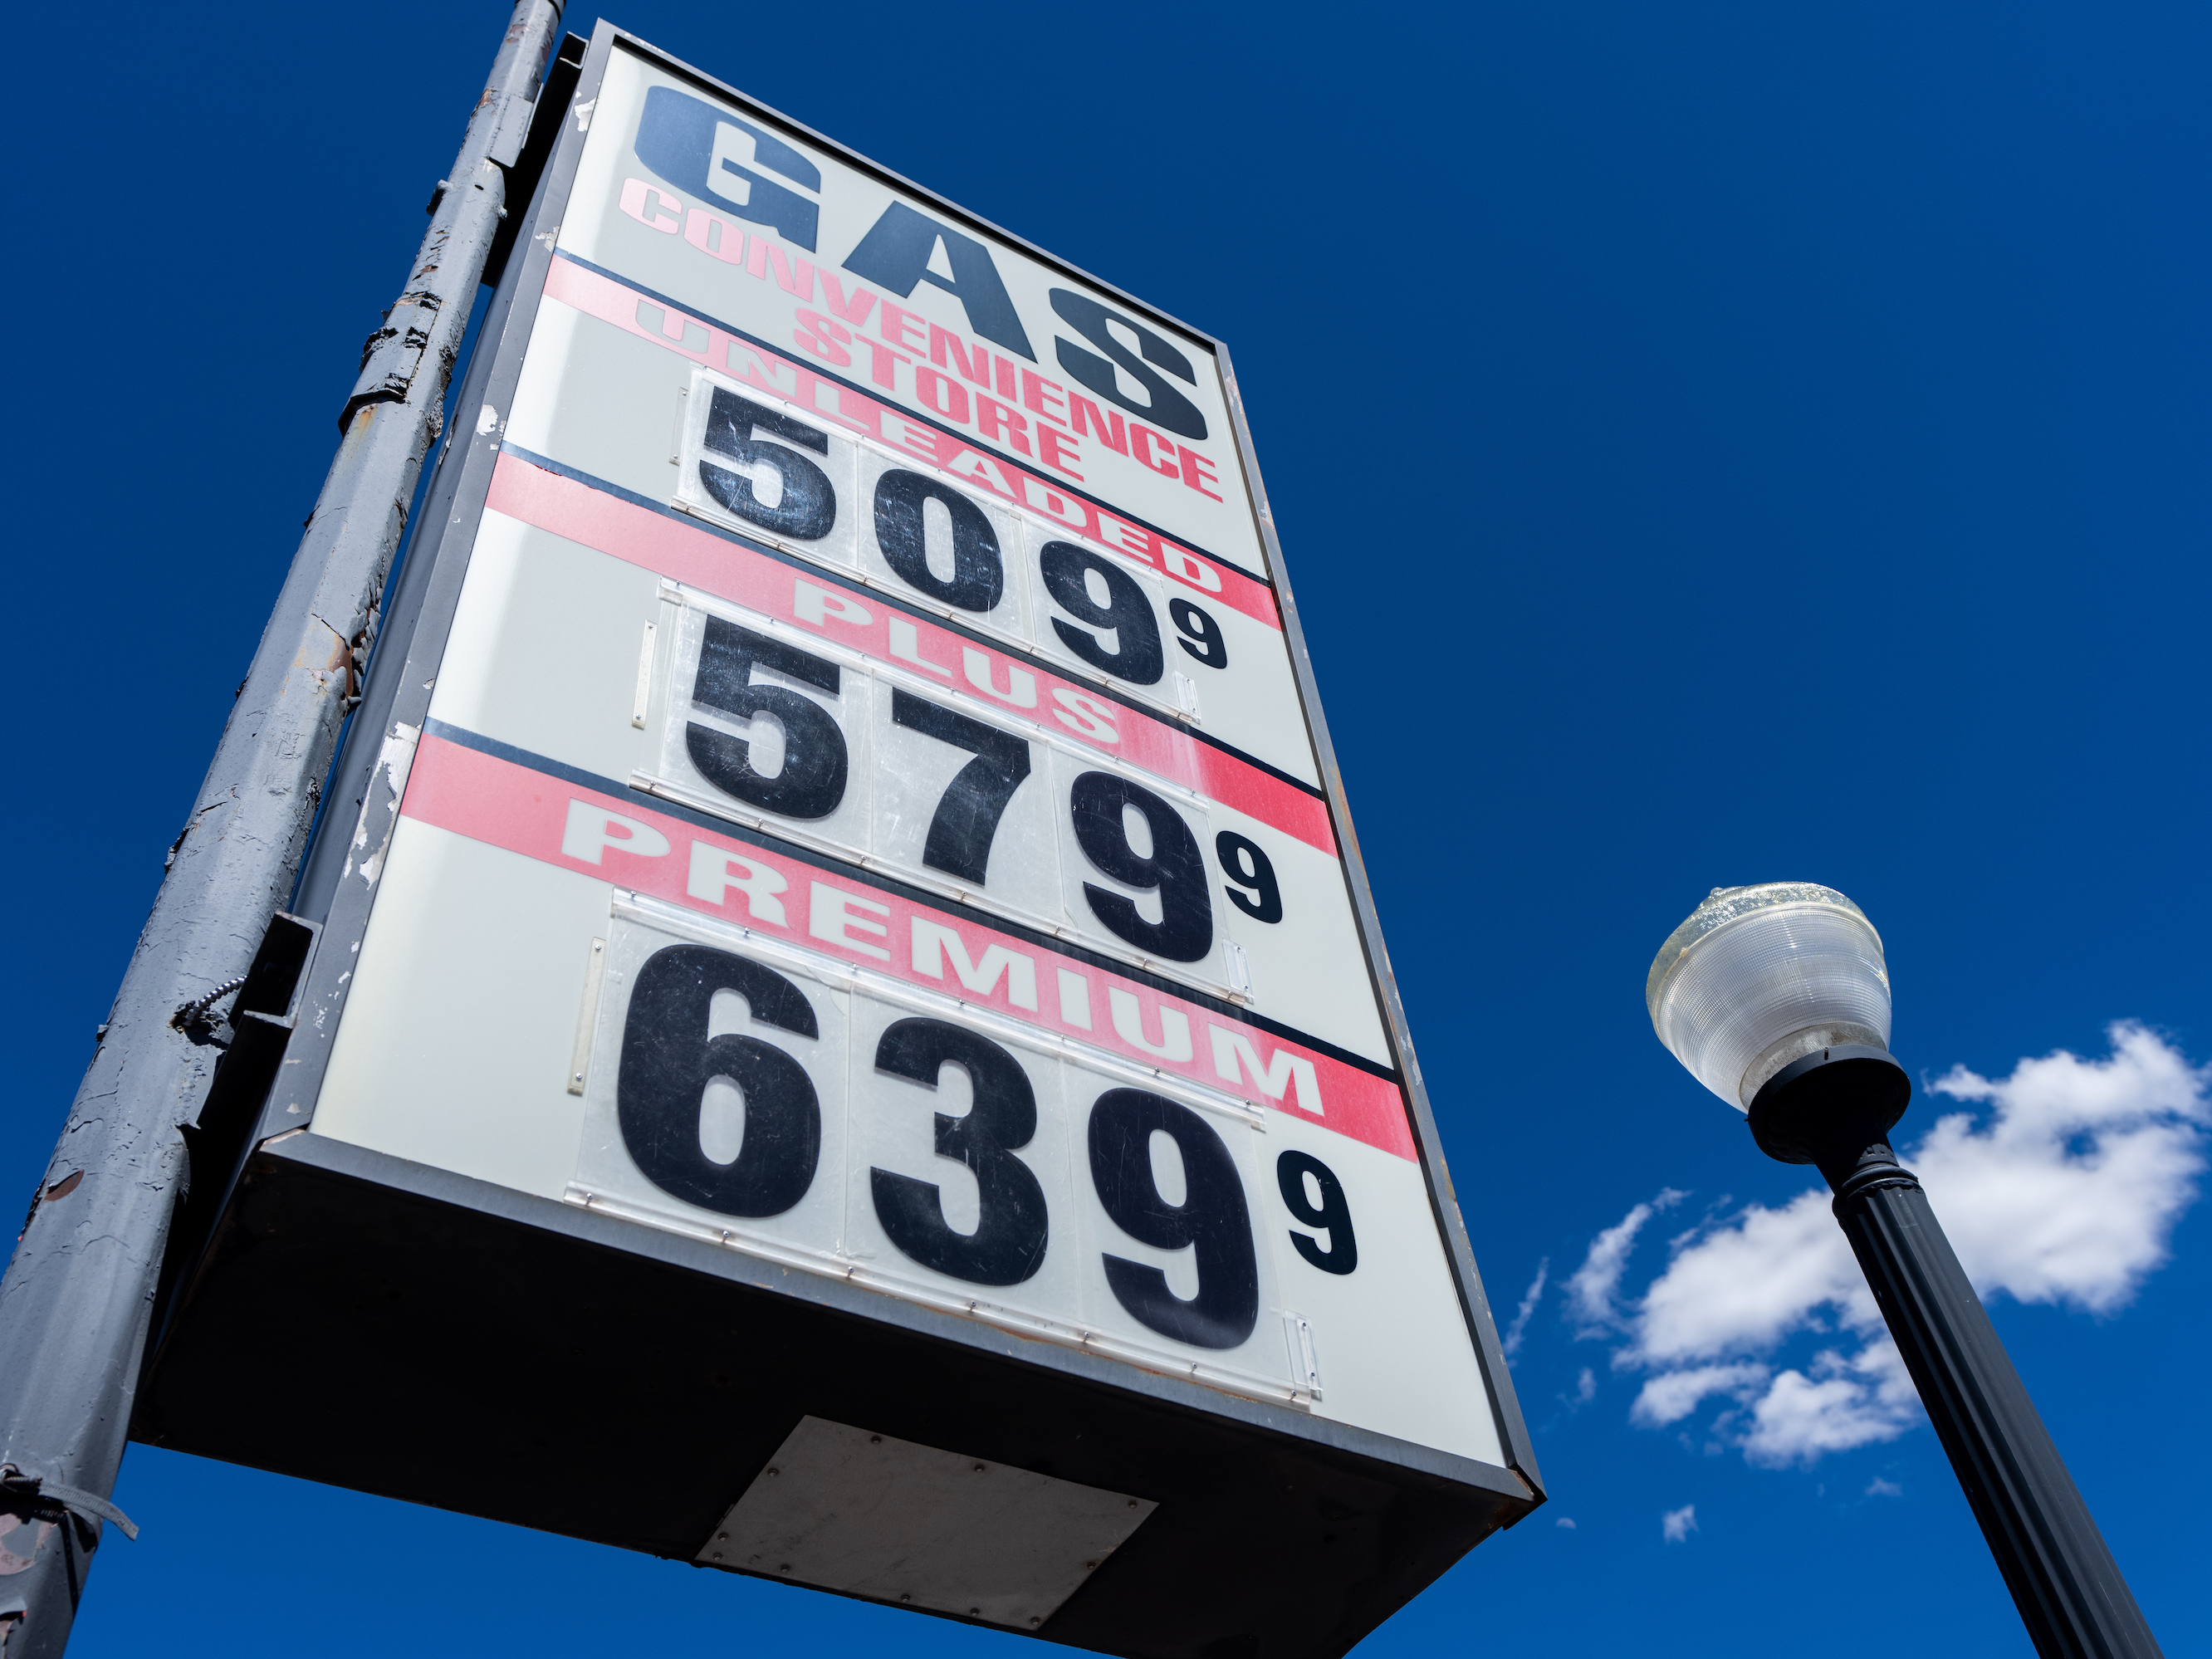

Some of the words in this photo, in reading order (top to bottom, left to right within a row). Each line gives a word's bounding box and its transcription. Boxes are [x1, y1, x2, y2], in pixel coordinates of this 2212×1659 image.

[619, 177, 1224, 503] CONVENIENCE
[634, 86, 1208, 441] GAS
[794, 307, 1084, 482] STORE
[635, 298, 1223, 594] UNLEADED
[792, 577, 1120, 744] PLUS
[560, 797, 1324, 1117] PREMIUM
